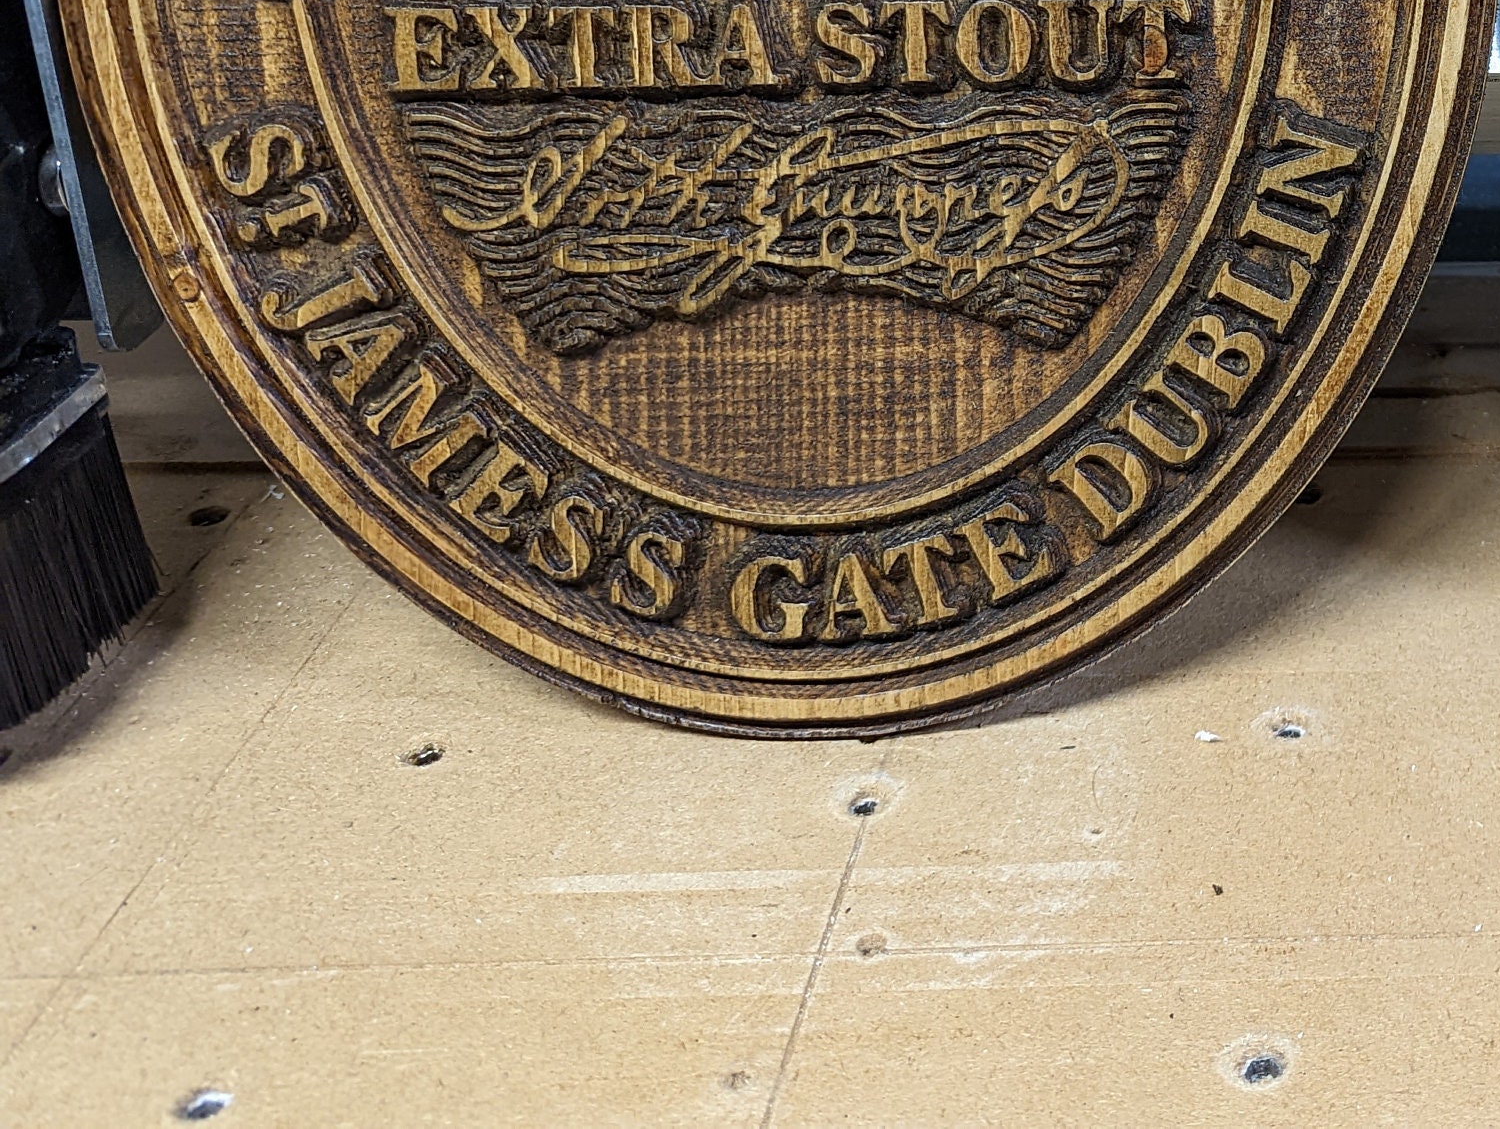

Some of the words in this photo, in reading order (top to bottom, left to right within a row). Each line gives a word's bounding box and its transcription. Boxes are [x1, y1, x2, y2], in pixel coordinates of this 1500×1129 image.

[385, 4, 788, 91] EXTRA
[730, 502, 1055, 642] GATE
[1050, 116, 1364, 540] DUBLIN
